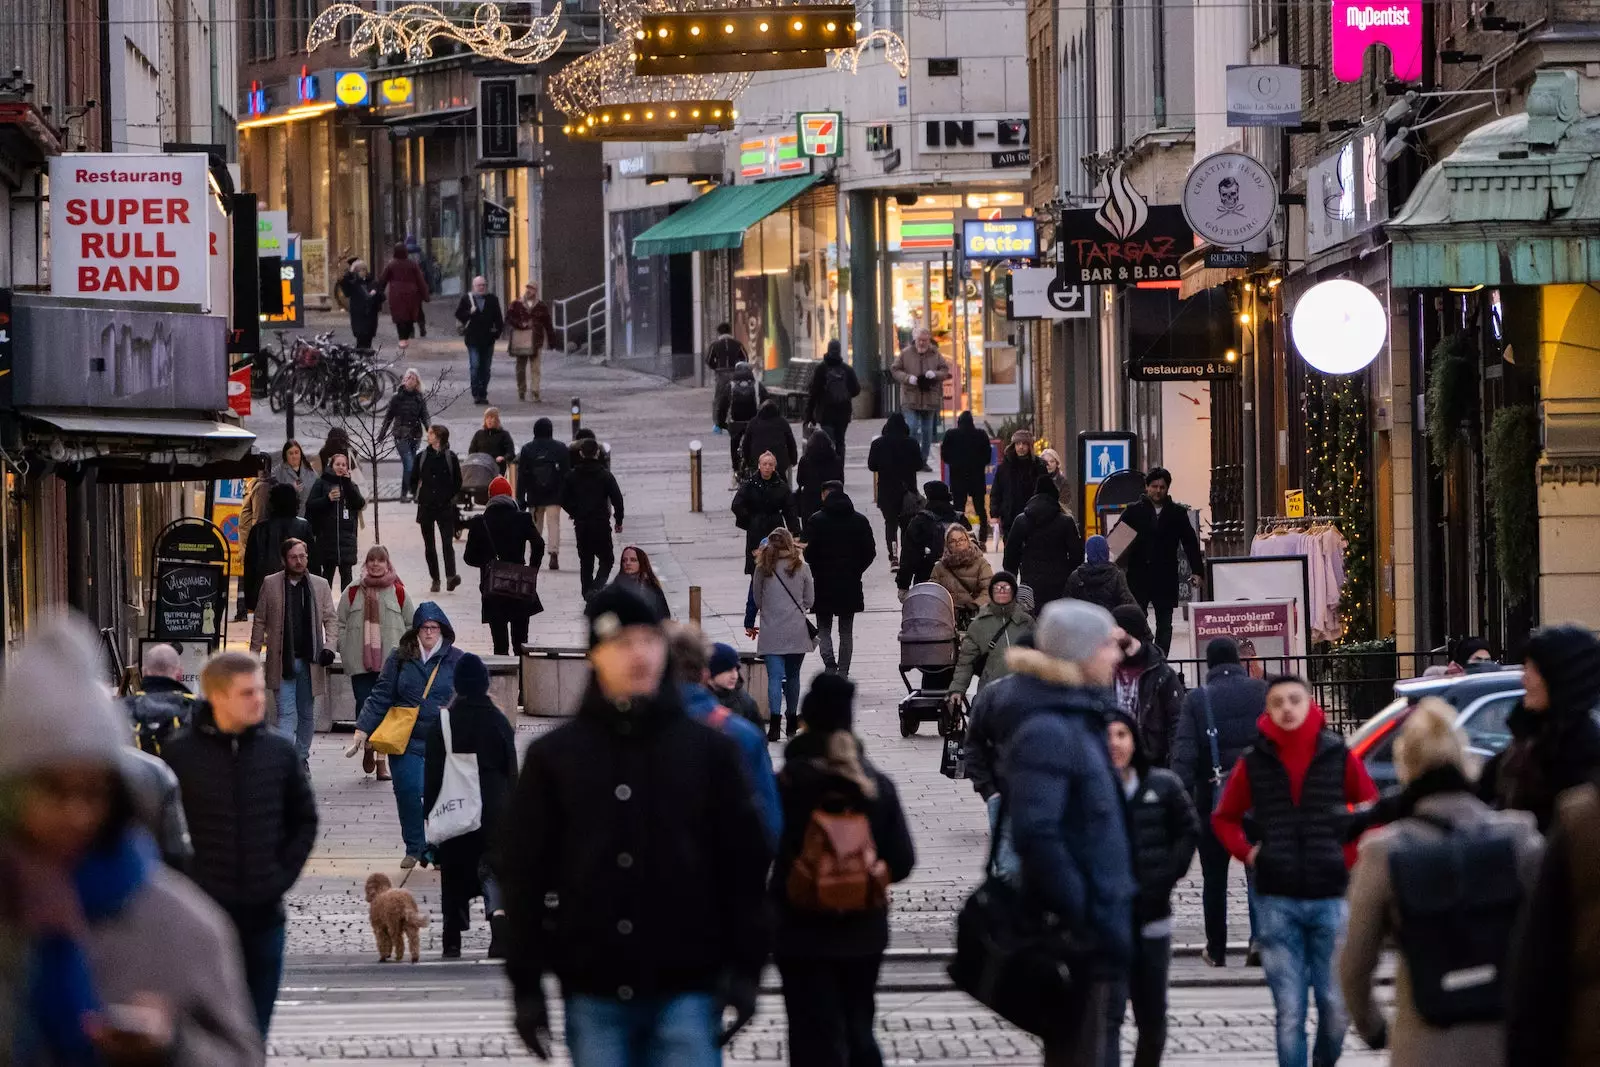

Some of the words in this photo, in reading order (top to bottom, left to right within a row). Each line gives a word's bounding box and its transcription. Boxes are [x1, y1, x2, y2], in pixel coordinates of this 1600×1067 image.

[1346, 6, 1410, 31] MyDentist
[1257, 76, 1271, 95] C
[999, 154, 1016, 163] Allt
[75, 169, 182, 185] Restaurang
[1193, 161, 1234, 195] CREATIVE
[66, 198, 190, 225] SUPER
[487, 214, 508, 224] Drop
[1205, 217, 1259, 237] GÖTEBORG
[81, 232, 176, 258] RULL
[1071, 237, 1180, 266] TARGAZ
[1210, 253, 1248, 262] REDKEN
[78, 265, 180, 292] BAND
[1081, 267, 1112, 281] BAR
[1118, 266, 1128, 278] &
[1134, 265, 1177, 279] B.B.Q
[1142, 363, 1204, 376] restaurang
[1206, 364, 1215, 374] &
[165, 574, 212, 590] VÄLKOMMEN
[1204, 611, 1275, 625] Tandproblem?
[1198, 625, 1231, 635] Dental
[1232, 623, 1283, 636] problems?
